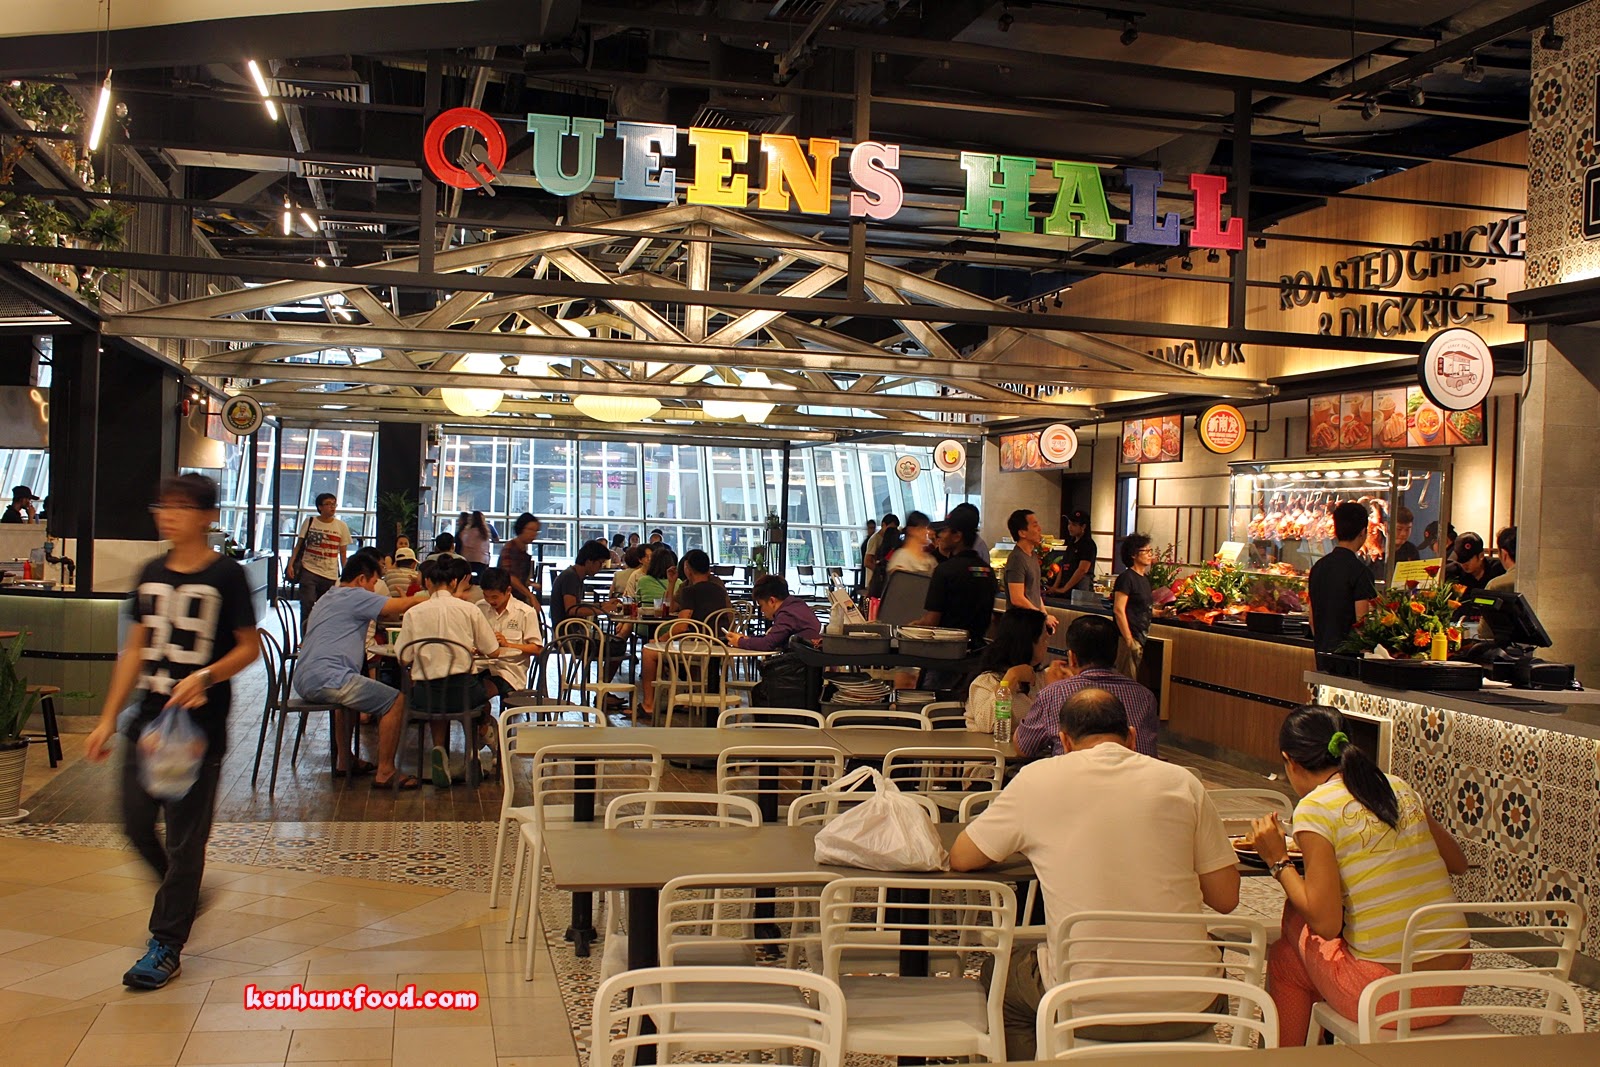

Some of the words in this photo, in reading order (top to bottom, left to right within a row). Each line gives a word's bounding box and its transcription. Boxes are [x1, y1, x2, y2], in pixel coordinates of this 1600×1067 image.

[423, 107, 904, 220] QUEENS
[958, 150, 1244, 250] HALL
[1279, 248, 1403, 310] ROASTED
[1406, 214, 1526, 281] CHICKE
[1318, 312, 1332, 336] &
[1340, 299, 1416, 338] DUCK
[1420, 278, 1496, 331] RICE
[1147, 342, 1193, 369] ANG
[1194, 340, 1245, 370] WOK
